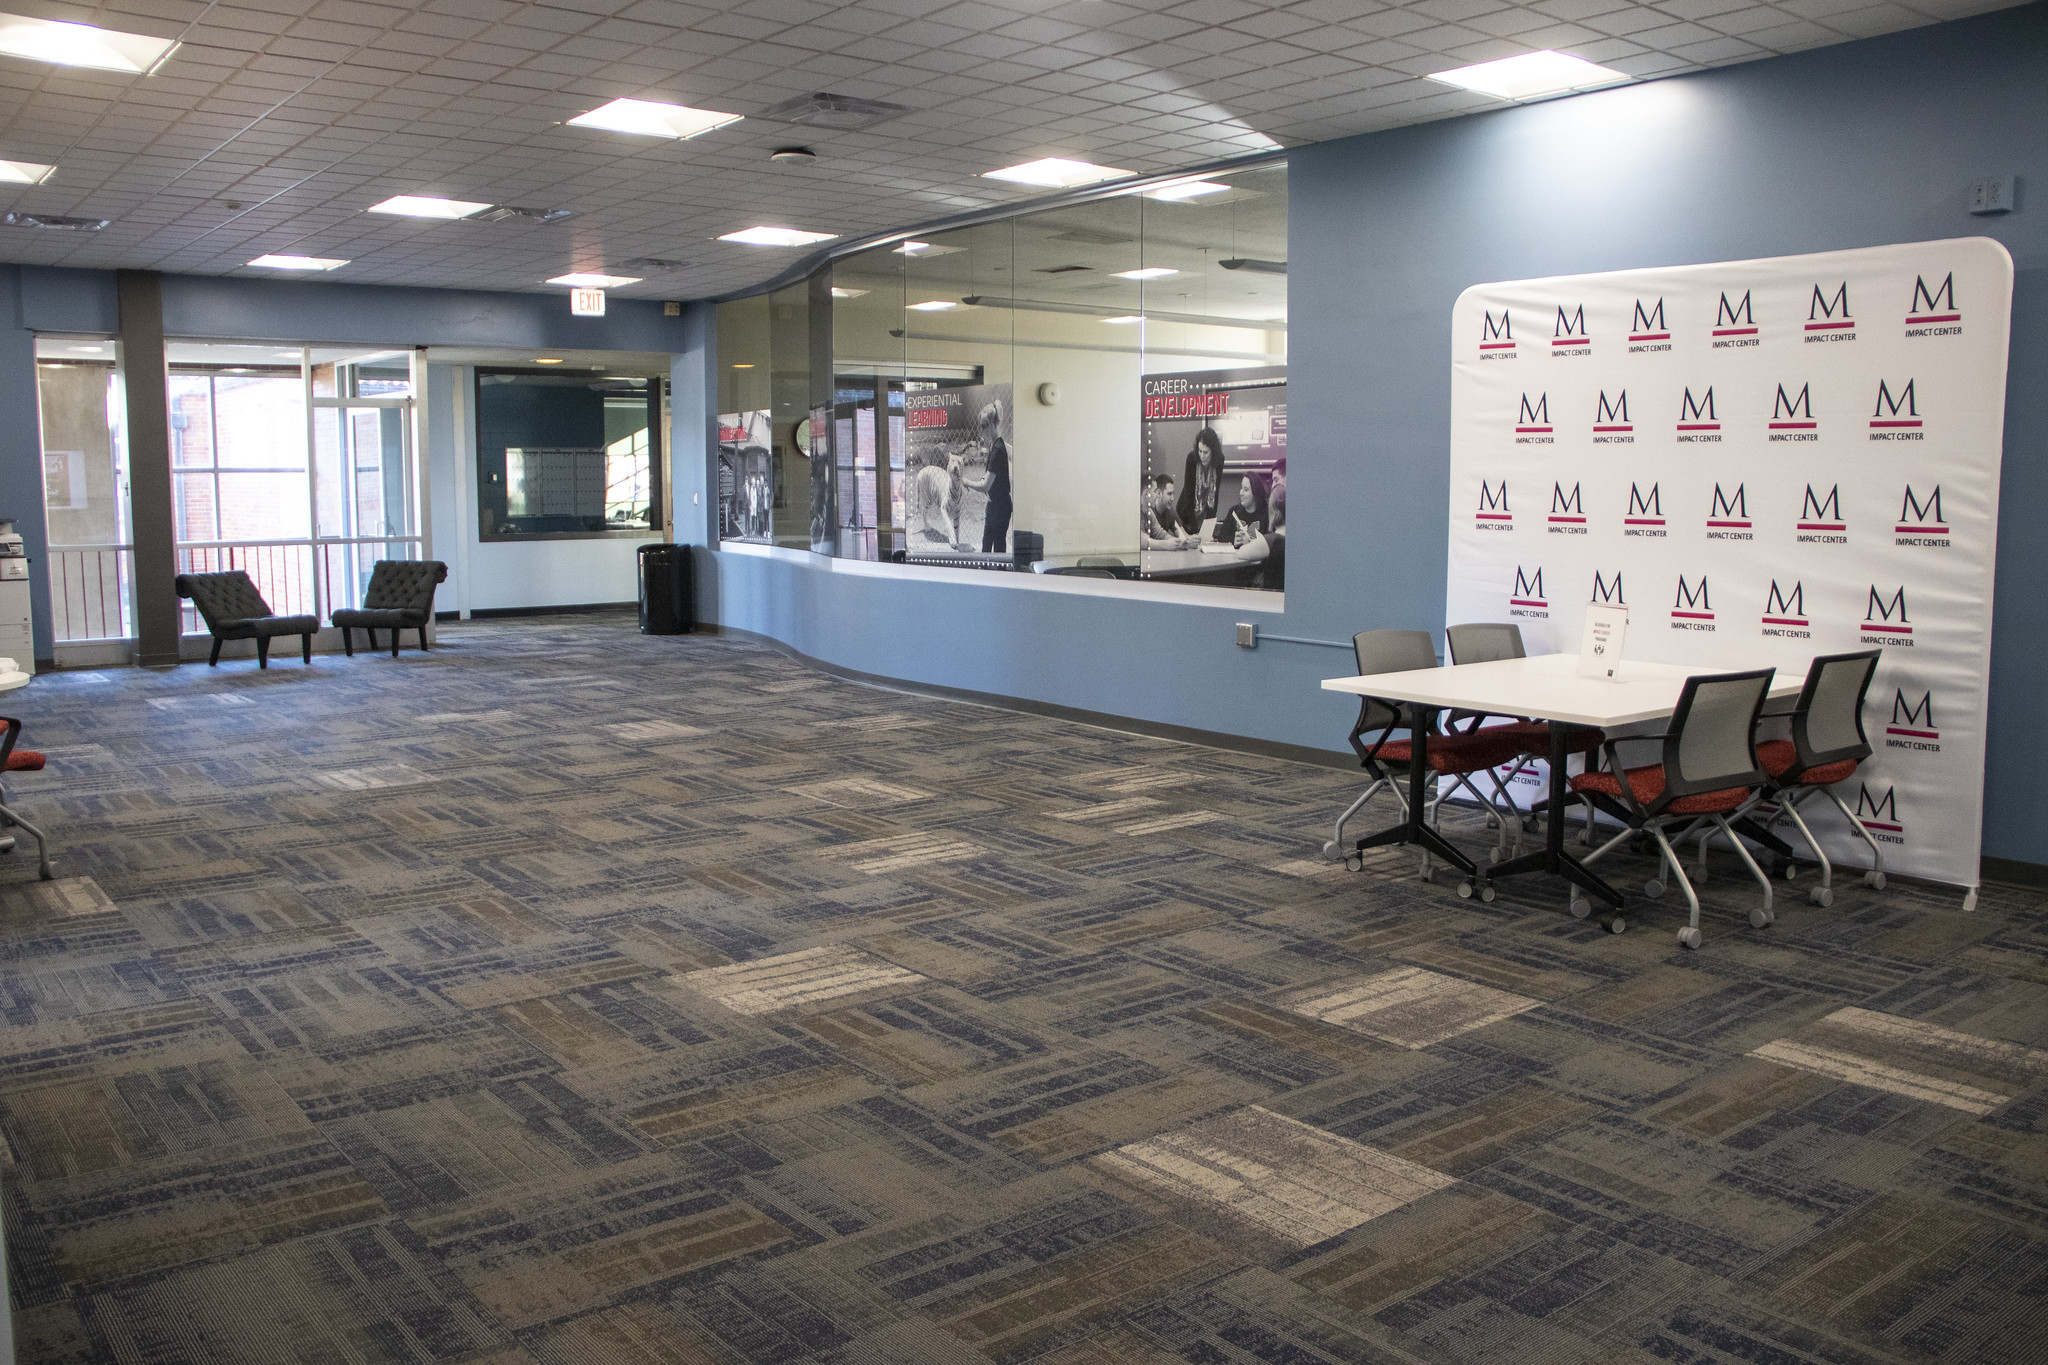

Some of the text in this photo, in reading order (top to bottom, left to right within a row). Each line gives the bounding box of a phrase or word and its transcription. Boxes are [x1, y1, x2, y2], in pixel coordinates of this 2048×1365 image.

[1807, 280, 1853, 320] M
[1908, 270, 1959, 313] M
[579, 292, 602, 311] EXIT
[1714, 288, 1757, 326] M
[1554, 303, 1587, 336] M
[1632, 296, 1668, 331] M
[1482, 309, 1514, 340] M
[1906, 326, 1962, 338] IMPACT CENTER
[1713, 338, 1759, 349] IMPACT CENTER
[1805, 332, 1856, 344] IMPACT CENTER
[1480, 352, 1517, 361] IMPACT CENTER
[1552, 348, 1591, 357] IMPACT CENTER
[1629, 343, 1671, 353] IMPACT CENTER
[1145, 378, 1188, 395] CAREER
[907, 393, 962, 408] EXPERIENTIAL
[1145, 393, 1230, 419] DEVELOPMENT
[1595, 388, 1630, 422] M
[1679, 385, 1719, 420] M
[1771, 381, 1815, 419] M
[1872, 377, 1921, 417] M
[1518, 391, 1551, 423] M
[907, 408, 948, 429] LEARNING
[1516, 436, 1554, 444] IMPACT CENTER
[1593, 435, 1634, 444] IMPACT CENTER
[1677, 434, 1722, 443] IMPACT CENTER
[1769, 433, 1818, 442] IMPACT CENTER
[1870, 431, 1923, 441] IMPACT CENTER
[1478, 479, 1511, 511] M
[1550, 480, 1584, 513] M
[1627, 481, 1664, 515] M
[1709, 482, 1750, 518] M
[1799, 482, 1845, 520] M
[1898, 483, 1948, 523] M
[1476, 523, 1513, 532] IMPACT CENTER
[1548, 526, 1587, 535] IMPACT CENTER
[1625, 529, 1666, 538] IMPACT CENTER
[1707, 531, 1753, 541] IMPACT CENTER
[1797, 534, 1847, 544] IMPACT CENTER
[1896, 537, 1950, 548] IMPACT CENTER
[1512, 565, 1547, 598] M
[1591, 569, 1626, 604] M
[1673, 573, 1713, 610] M
[1764, 578, 1807, 616] M
[1863, 583, 1911, 623] M
[1510, 609, 1548, 619] IMPACT CENTER
[1671, 621, 1715, 632] IMPACT CENTER
[1762, 628, 1810, 640] IMPACT CENTER
[1861, 636, 1914, 647] IMPACT CENTER
[1888, 687, 1938, 729] M
[1886, 739, 1940, 752] IMPACT CENTER
[1521, 777, 1541, 787] CENTER
[1854, 781, 1901, 822] M
[1777, 819, 1798, 829] CENTE
[1877, 833, 1904, 845] CENTER
